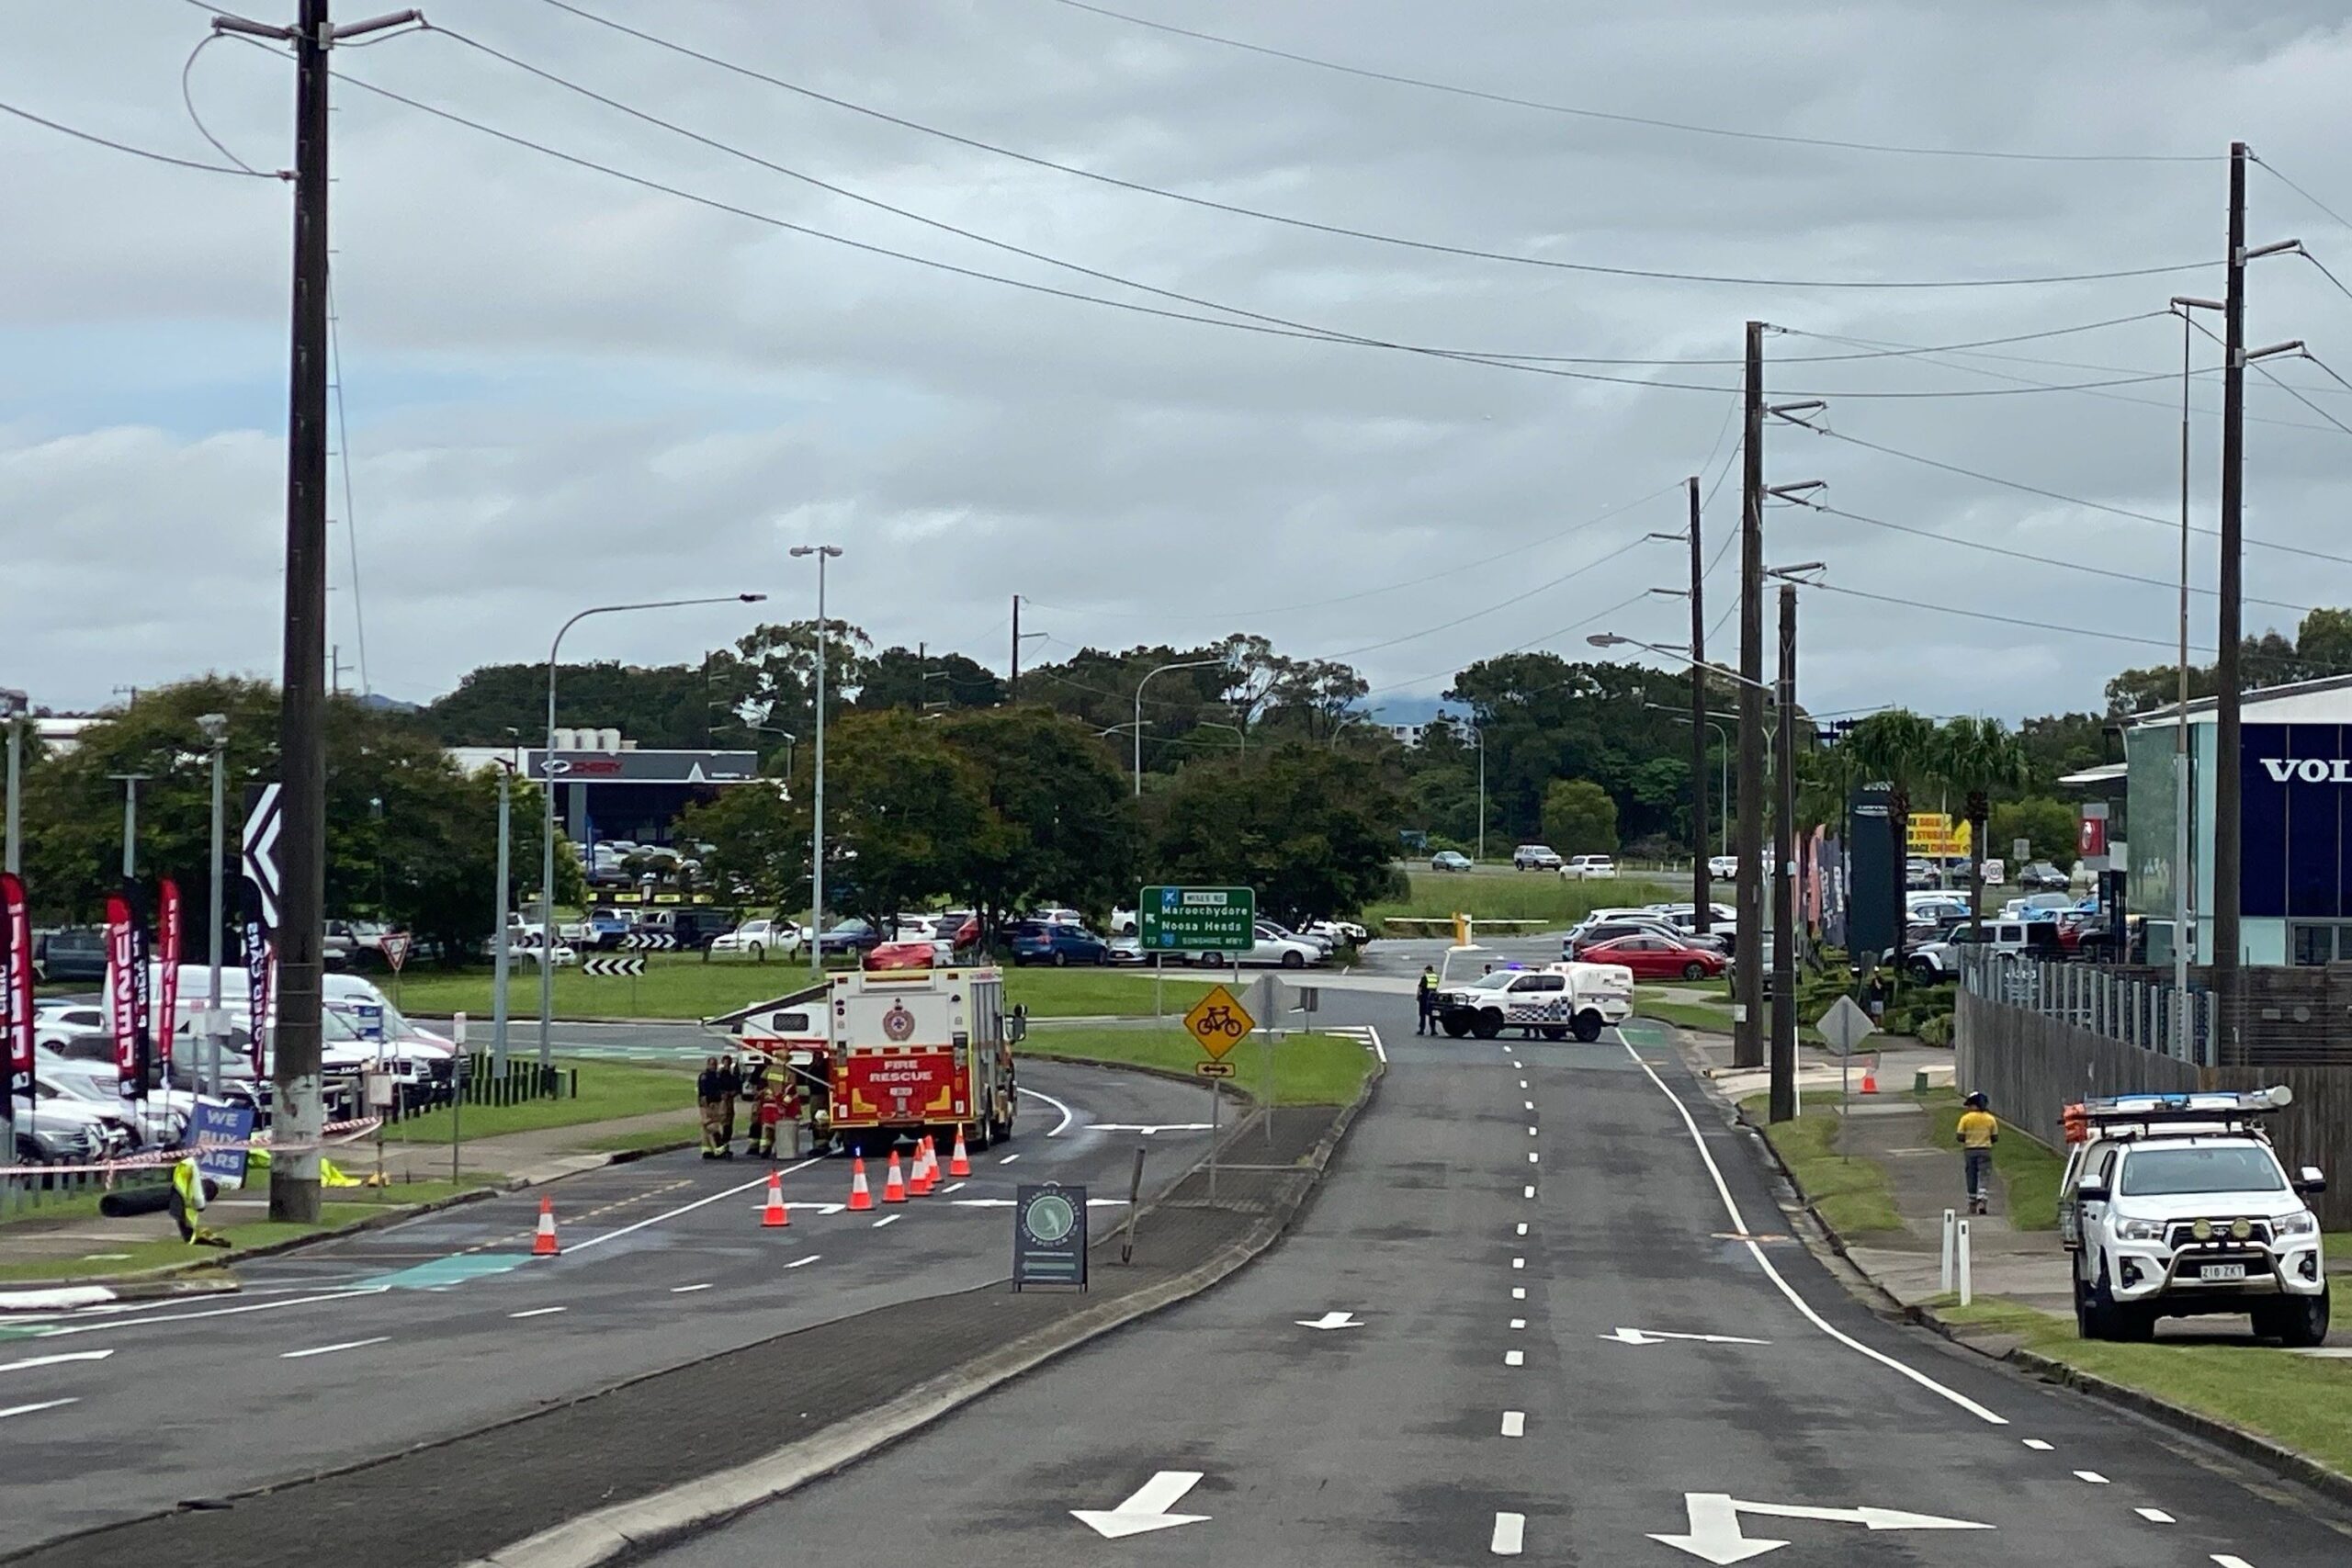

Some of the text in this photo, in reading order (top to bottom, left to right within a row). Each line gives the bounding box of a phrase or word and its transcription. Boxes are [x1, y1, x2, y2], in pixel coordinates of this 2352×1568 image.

[2259, 758, 2352, 782] VOL
[1161, 906, 1248, 918] Maroochydore
[1161, 921, 1242, 931] Noosa Heads
[884, 1060, 919, 1070] FIRE
[869, 1071, 933, 1082] RESCUE
[207, 1109, 239, 1127] WE
[200, 1152, 239, 1169] ARS
